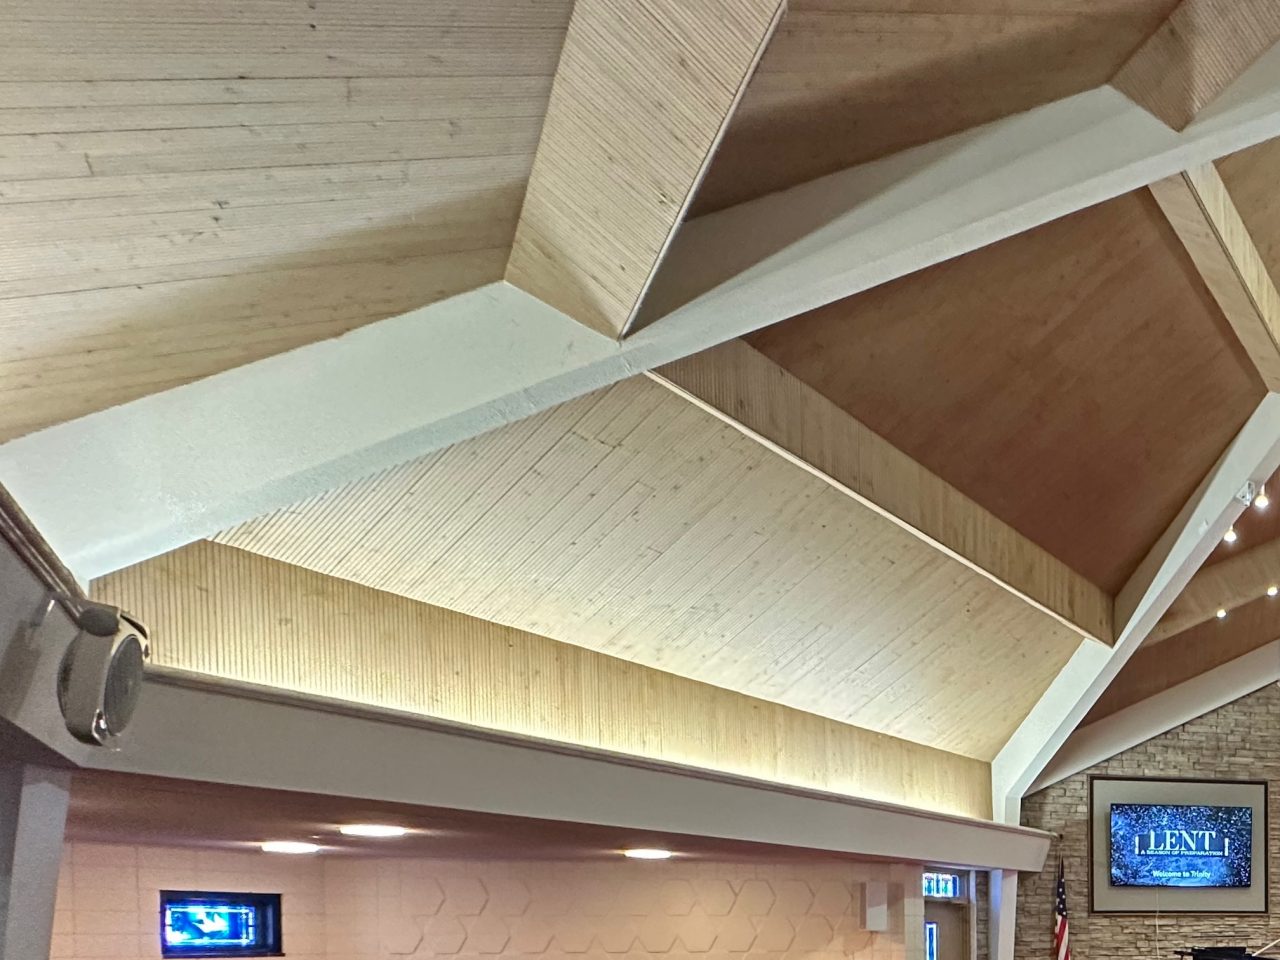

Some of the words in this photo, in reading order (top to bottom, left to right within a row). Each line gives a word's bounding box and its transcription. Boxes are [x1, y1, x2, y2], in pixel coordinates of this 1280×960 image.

[1148, 829, 1216, 851] LENT
[1152, 870, 1182, 878] Welcome
[1182, 870, 1190, 878] to
[1190, 870, 1211, 879] Trinity
